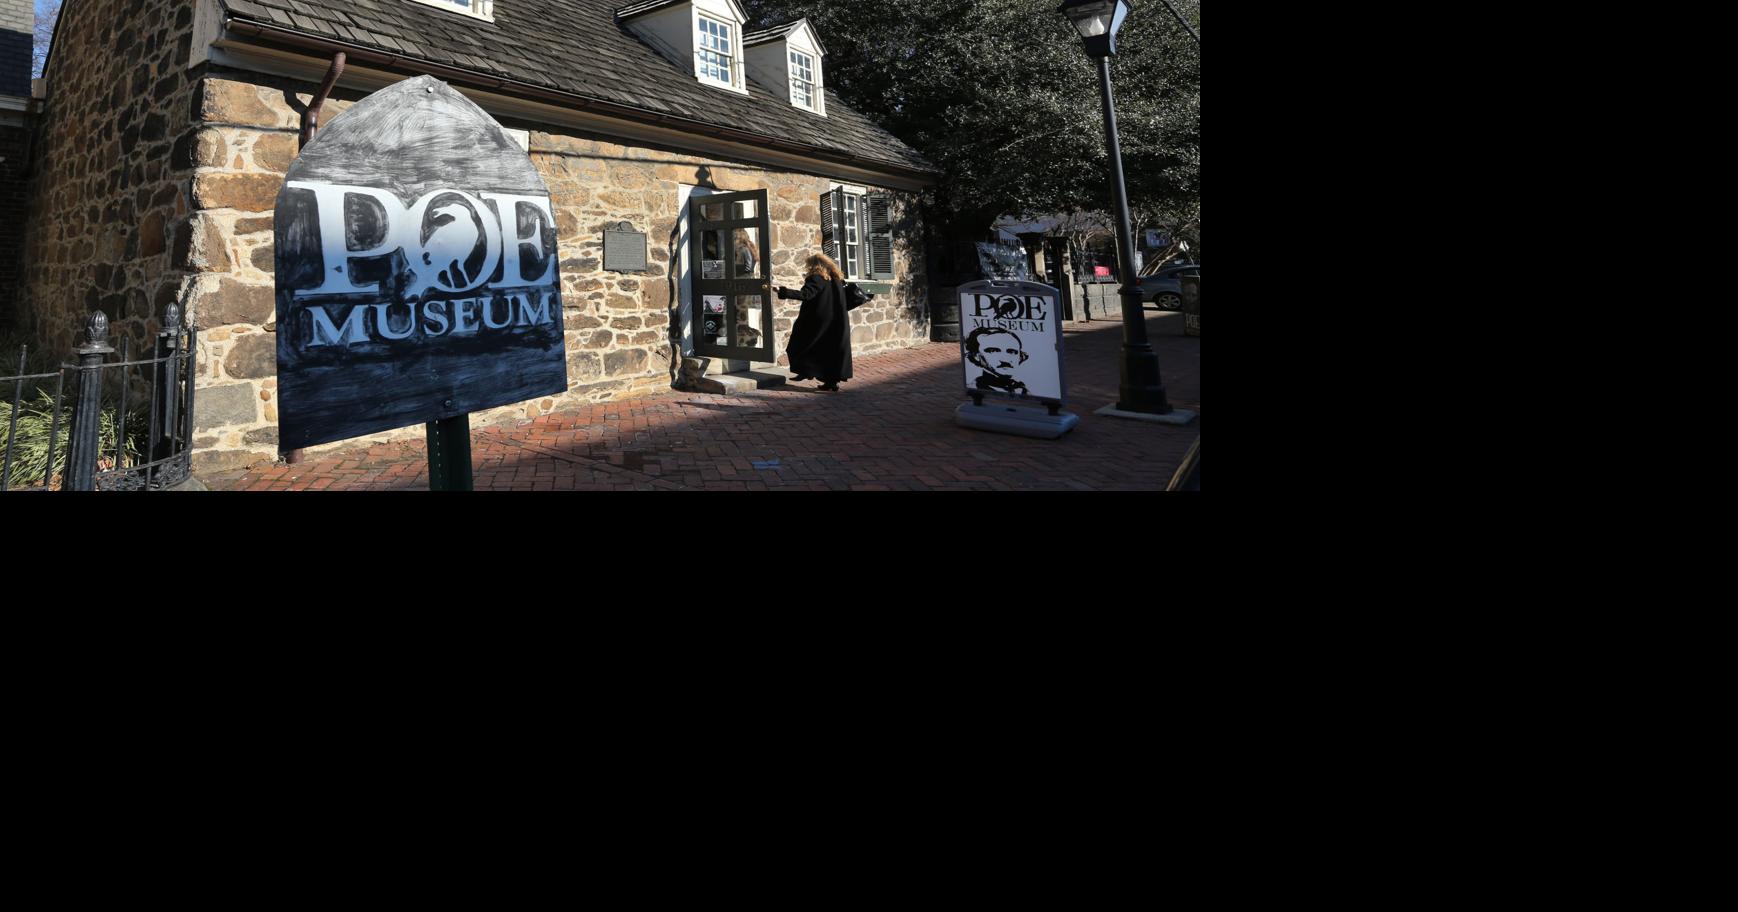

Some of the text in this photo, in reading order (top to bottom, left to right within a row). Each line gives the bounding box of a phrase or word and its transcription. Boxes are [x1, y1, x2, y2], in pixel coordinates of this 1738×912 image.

[287, 180, 555, 301] POE
[305, 292, 554, 348] MUSEUM
[968, 293, 1047, 320] POE
